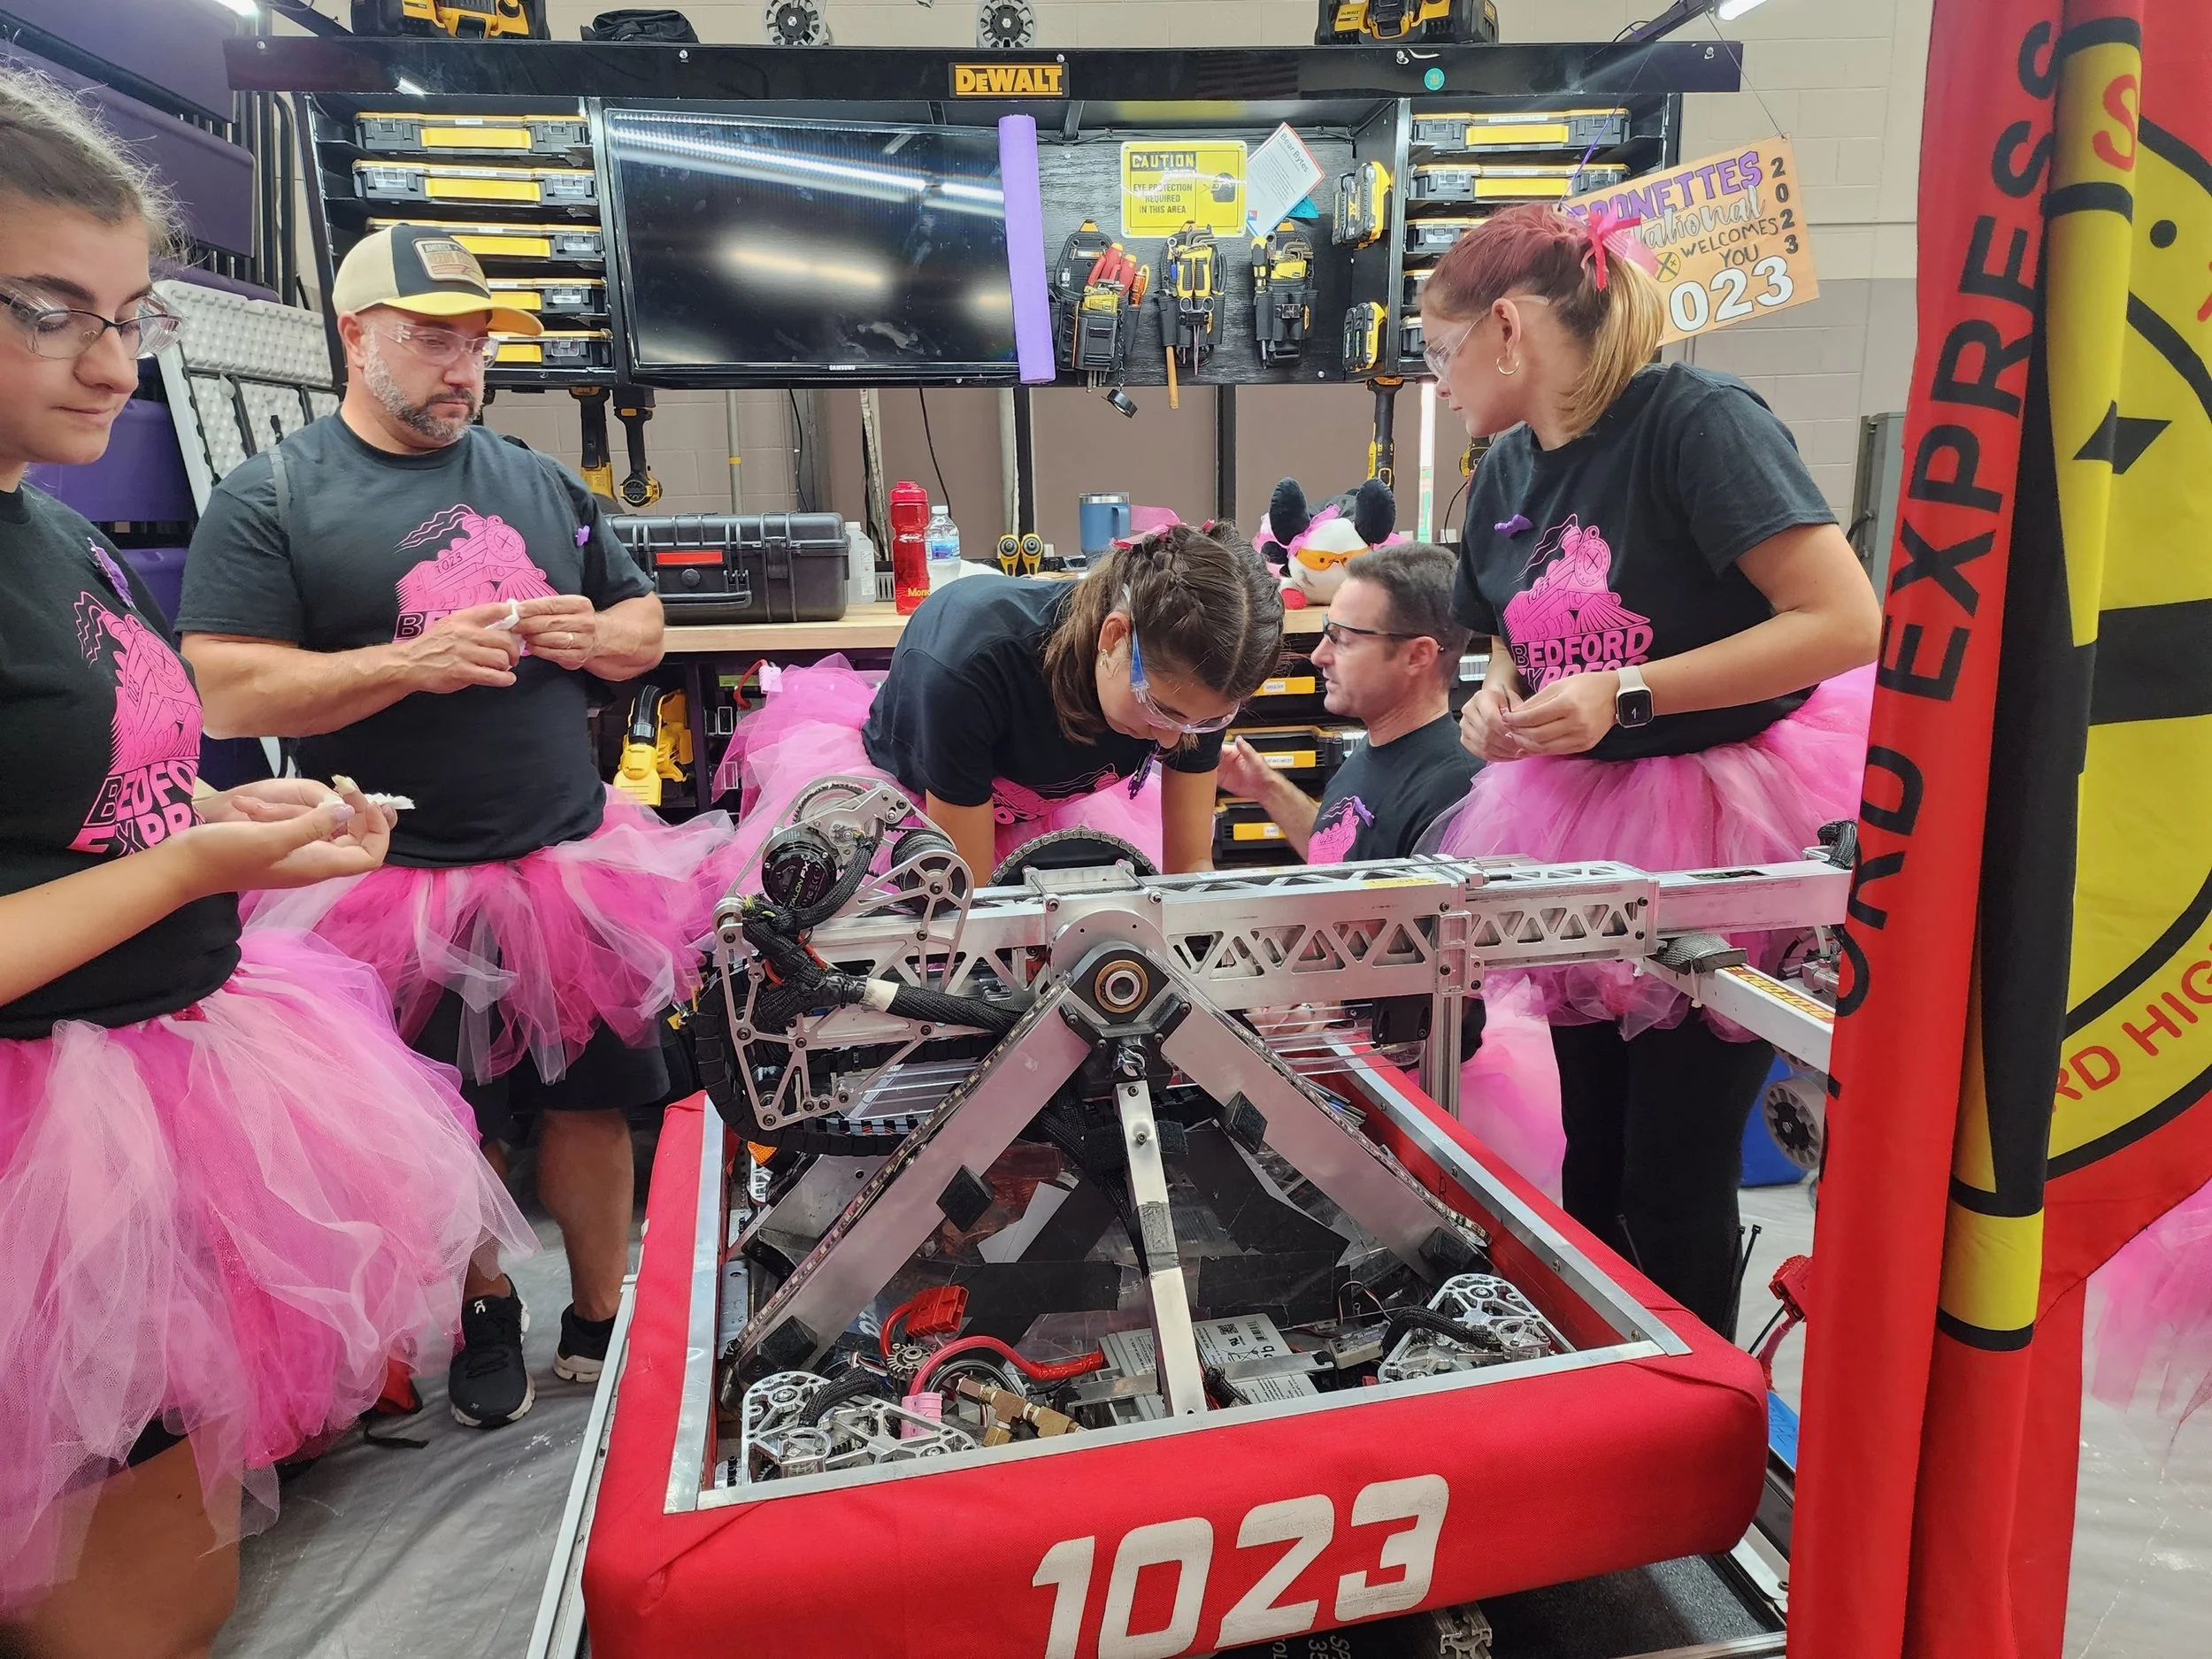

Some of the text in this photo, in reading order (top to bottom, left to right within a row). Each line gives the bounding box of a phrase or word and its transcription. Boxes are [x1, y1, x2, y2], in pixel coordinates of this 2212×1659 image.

[1132, 154, 1194, 168] CAUTION
[1279, 133, 1310, 173] Bear Bytes
[1133, 183, 1193, 192] EYE PROTECTION
[1145, 194, 1181, 204] REQUIRED
[1139, 204, 1187, 214] IN THIS AREA
[1632, 183, 1765, 250] ational
[1680, 217, 1779, 259] WELCOMES
[1718, 243, 1759, 268] YOU
[1658, 255, 1794, 342] 023
[434, 550, 464, 574] 1023
[1526, 577, 1550, 605] 1023
[1510, 625, 1655, 670] BEDFORD
[788, 860, 811, 909] TALON FX
[1032, 1473, 1450, 1659] 1023
